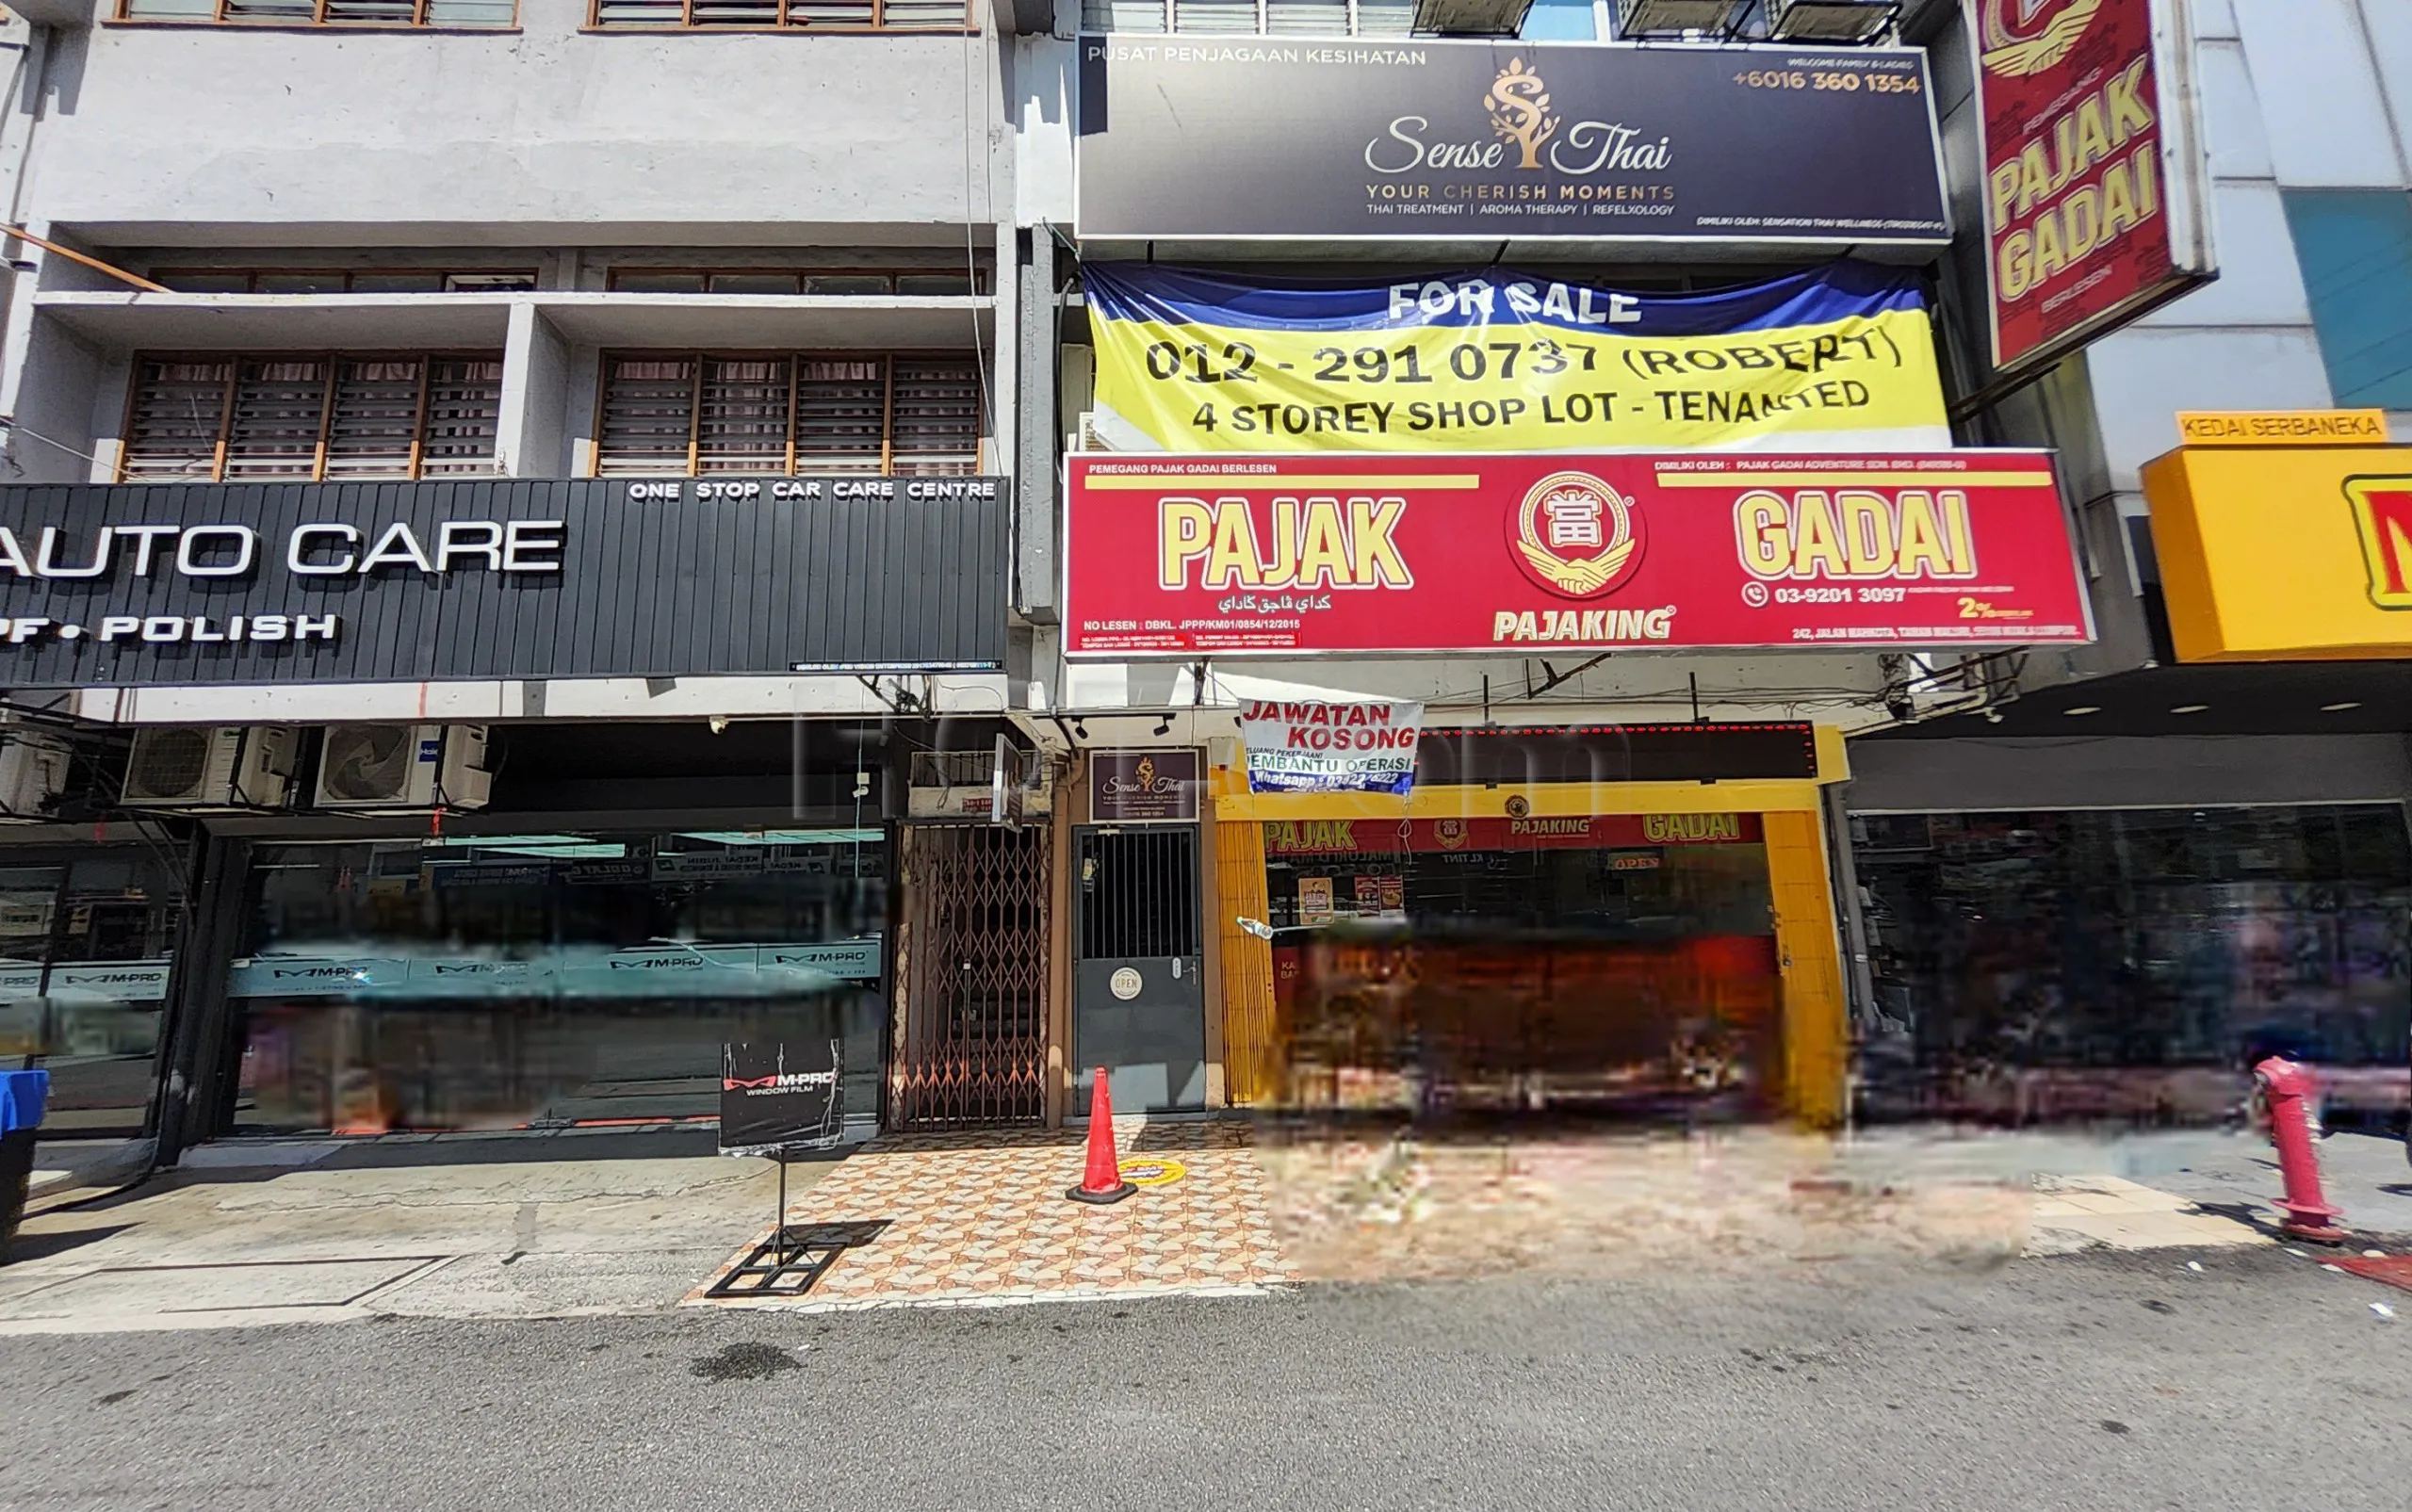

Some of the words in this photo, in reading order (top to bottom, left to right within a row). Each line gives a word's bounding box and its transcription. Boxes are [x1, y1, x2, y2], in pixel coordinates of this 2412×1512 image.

[1087, 46, 1157, 62] PUSAT
[1165, 47, 1299, 63] PENJAGAAN
[1306, 49, 1426, 66] KESIHATAN
[1733, 71, 1806, 90] +6016
[1810, 73, 1860, 92] 360
[1864, 73, 1921, 94] 1354
[1364, 116, 1505, 174] Sense
[1550, 121, 1672, 175] Thai
[1988, 52, 2155, 236] PAJAK
[1366, 185, 1430, 201] YOUR
[1443, 185, 1547, 201] CHERISH
[1559, 185, 1675, 201] MOMENTS
[1366, 203, 1394, 216] THAI
[1396, 203, 1464, 216] TREATMENT
[1479, 203, 1524, 216] AROMA
[1525, 203, 1578, 217] THERAPY
[1996, 139, 2159, 303] GADAI
[1387, 278, 1495, 321] FOR
[1508, 282, 1644, 325] SALE
[1146, 340, 1258, 383] 012
[1312, 342, 1433, 383] 291
[1449, 338, 1597, 382] 0737
[1622, 325, 1902, 381] (ROBERT)
[1192, 402, 1218, 432] 4
[1231, 401, 1395, 434] STOREY
[1407, 398, 1525, 431] SHOP
[1543, 392, 1619, 424] LOT
[2179, 418, 2249, 437] KEDAI
[2250, 416, 2383, 437] SERBANEKA
[1088, 464, 1149, 474] PEMEGANG
[1150, 464, 1185, 474] PAJAK
[1187, 464, 1220, 474] GADAI
[1222, 463, 1277, 474] BERLESEN
[1736, 461, 1770, 470] PAJAK
[629, 483, 681, 499] ONE
[696, 482, 761, 499] STOP
[773, 481, 822, 498] CAR
[833, 481, 894, 498] CARE
[907, 482, 996, 498] CENTRE
[1158, 496, 1414, 591] PAJAK
[1732, 490, 1978, 580] GADAI
[286, 519, 564, 575] CARE
[1774, 587, 1853, 604] 03-9201
[1857, 587, 1907, 604] 3097
[100, 613, 338, 642] POLISH
[1084, 620, 1101, 631] NO
[1101, 620, 1137, 631] LESEN
[1493, 609, 1672, 642] PAJAKING
[1243, 701, 1391, 726] JAWATAN
[1287, 726, 1415, 751] KOSONG
[1247, 755, 1338, 773] EMBANTU
[1345, 756, 1411, 772] OPERASI
[1102, 776, 1142, 794] Sense
[1152, 776, 1186, 794] Thai
[1264, 821, 1358, 853] PAJAK
[1510, 819, 1591, 836] PAJAKING
[1642, 813, 1741, 841] GADAI
[1613, 857, 1660, 870] OPEN
[1115, 978, 1138, 989] OPEN
[745, 1086, 790, 1097] WINDOW
[790, 1085, 814, 1094] FILM
